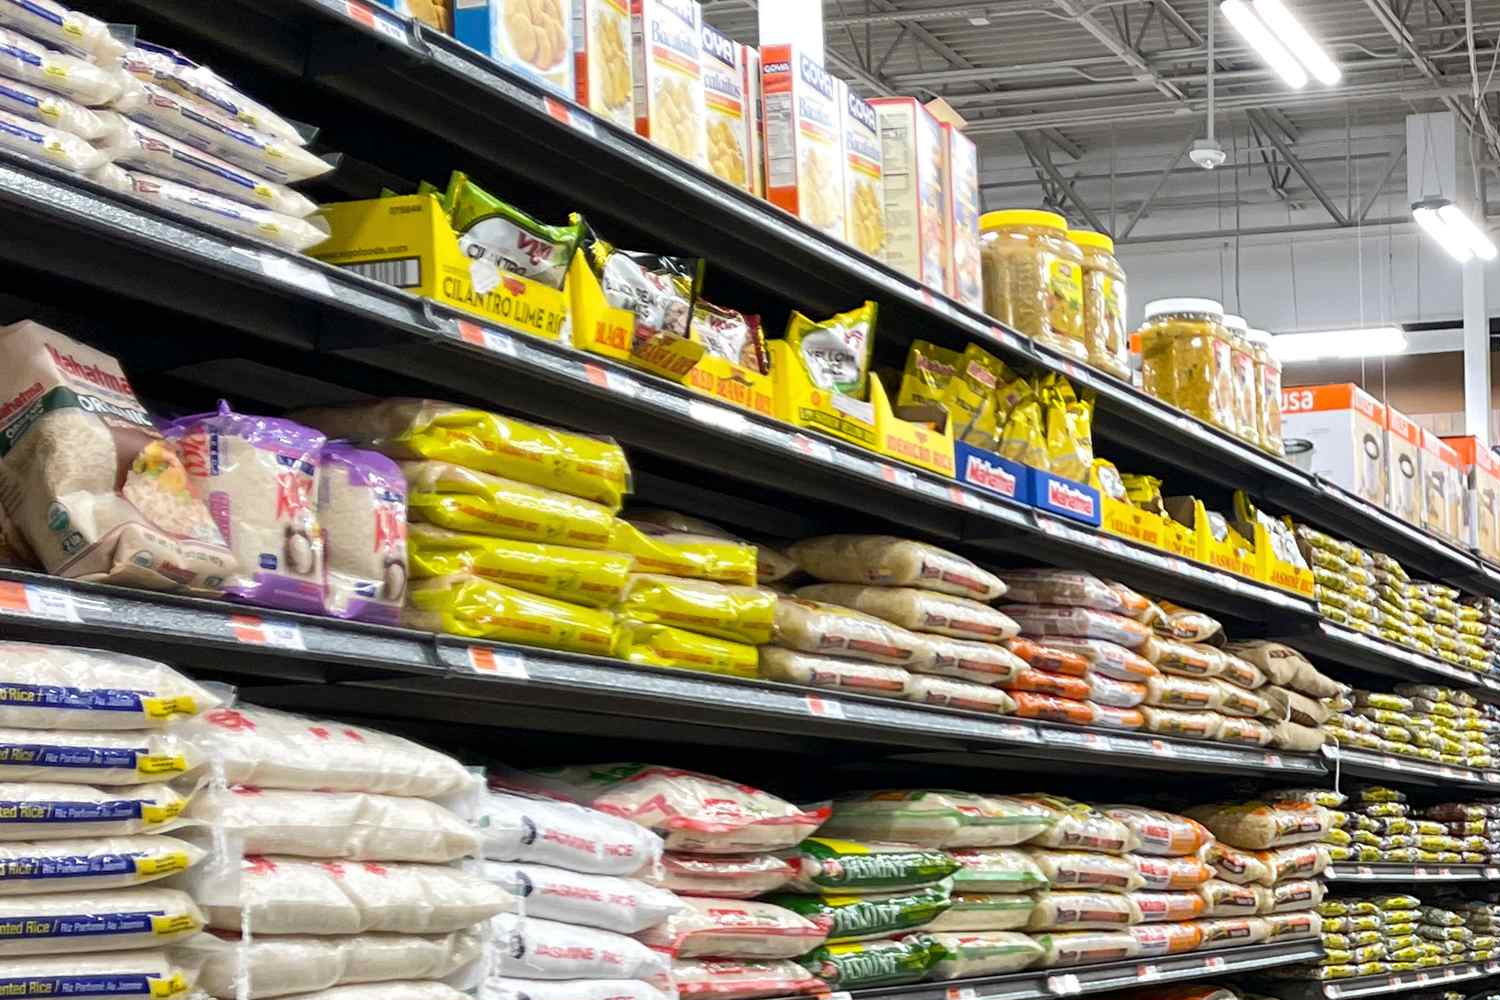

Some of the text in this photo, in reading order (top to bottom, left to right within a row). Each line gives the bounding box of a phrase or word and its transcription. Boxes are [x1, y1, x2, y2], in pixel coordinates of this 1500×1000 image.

[702, 28, 736, 66] OYA
[763, 62, 791, 74] GOYA
[442, 276, 567, 336] CILANTRO LIME RIC
[20, 803, 46, 818] Rice
[26, 920, 50, 934] Rice
[61, 924, 72, 933] Riz
[30, 981, 53, 993] Rice
